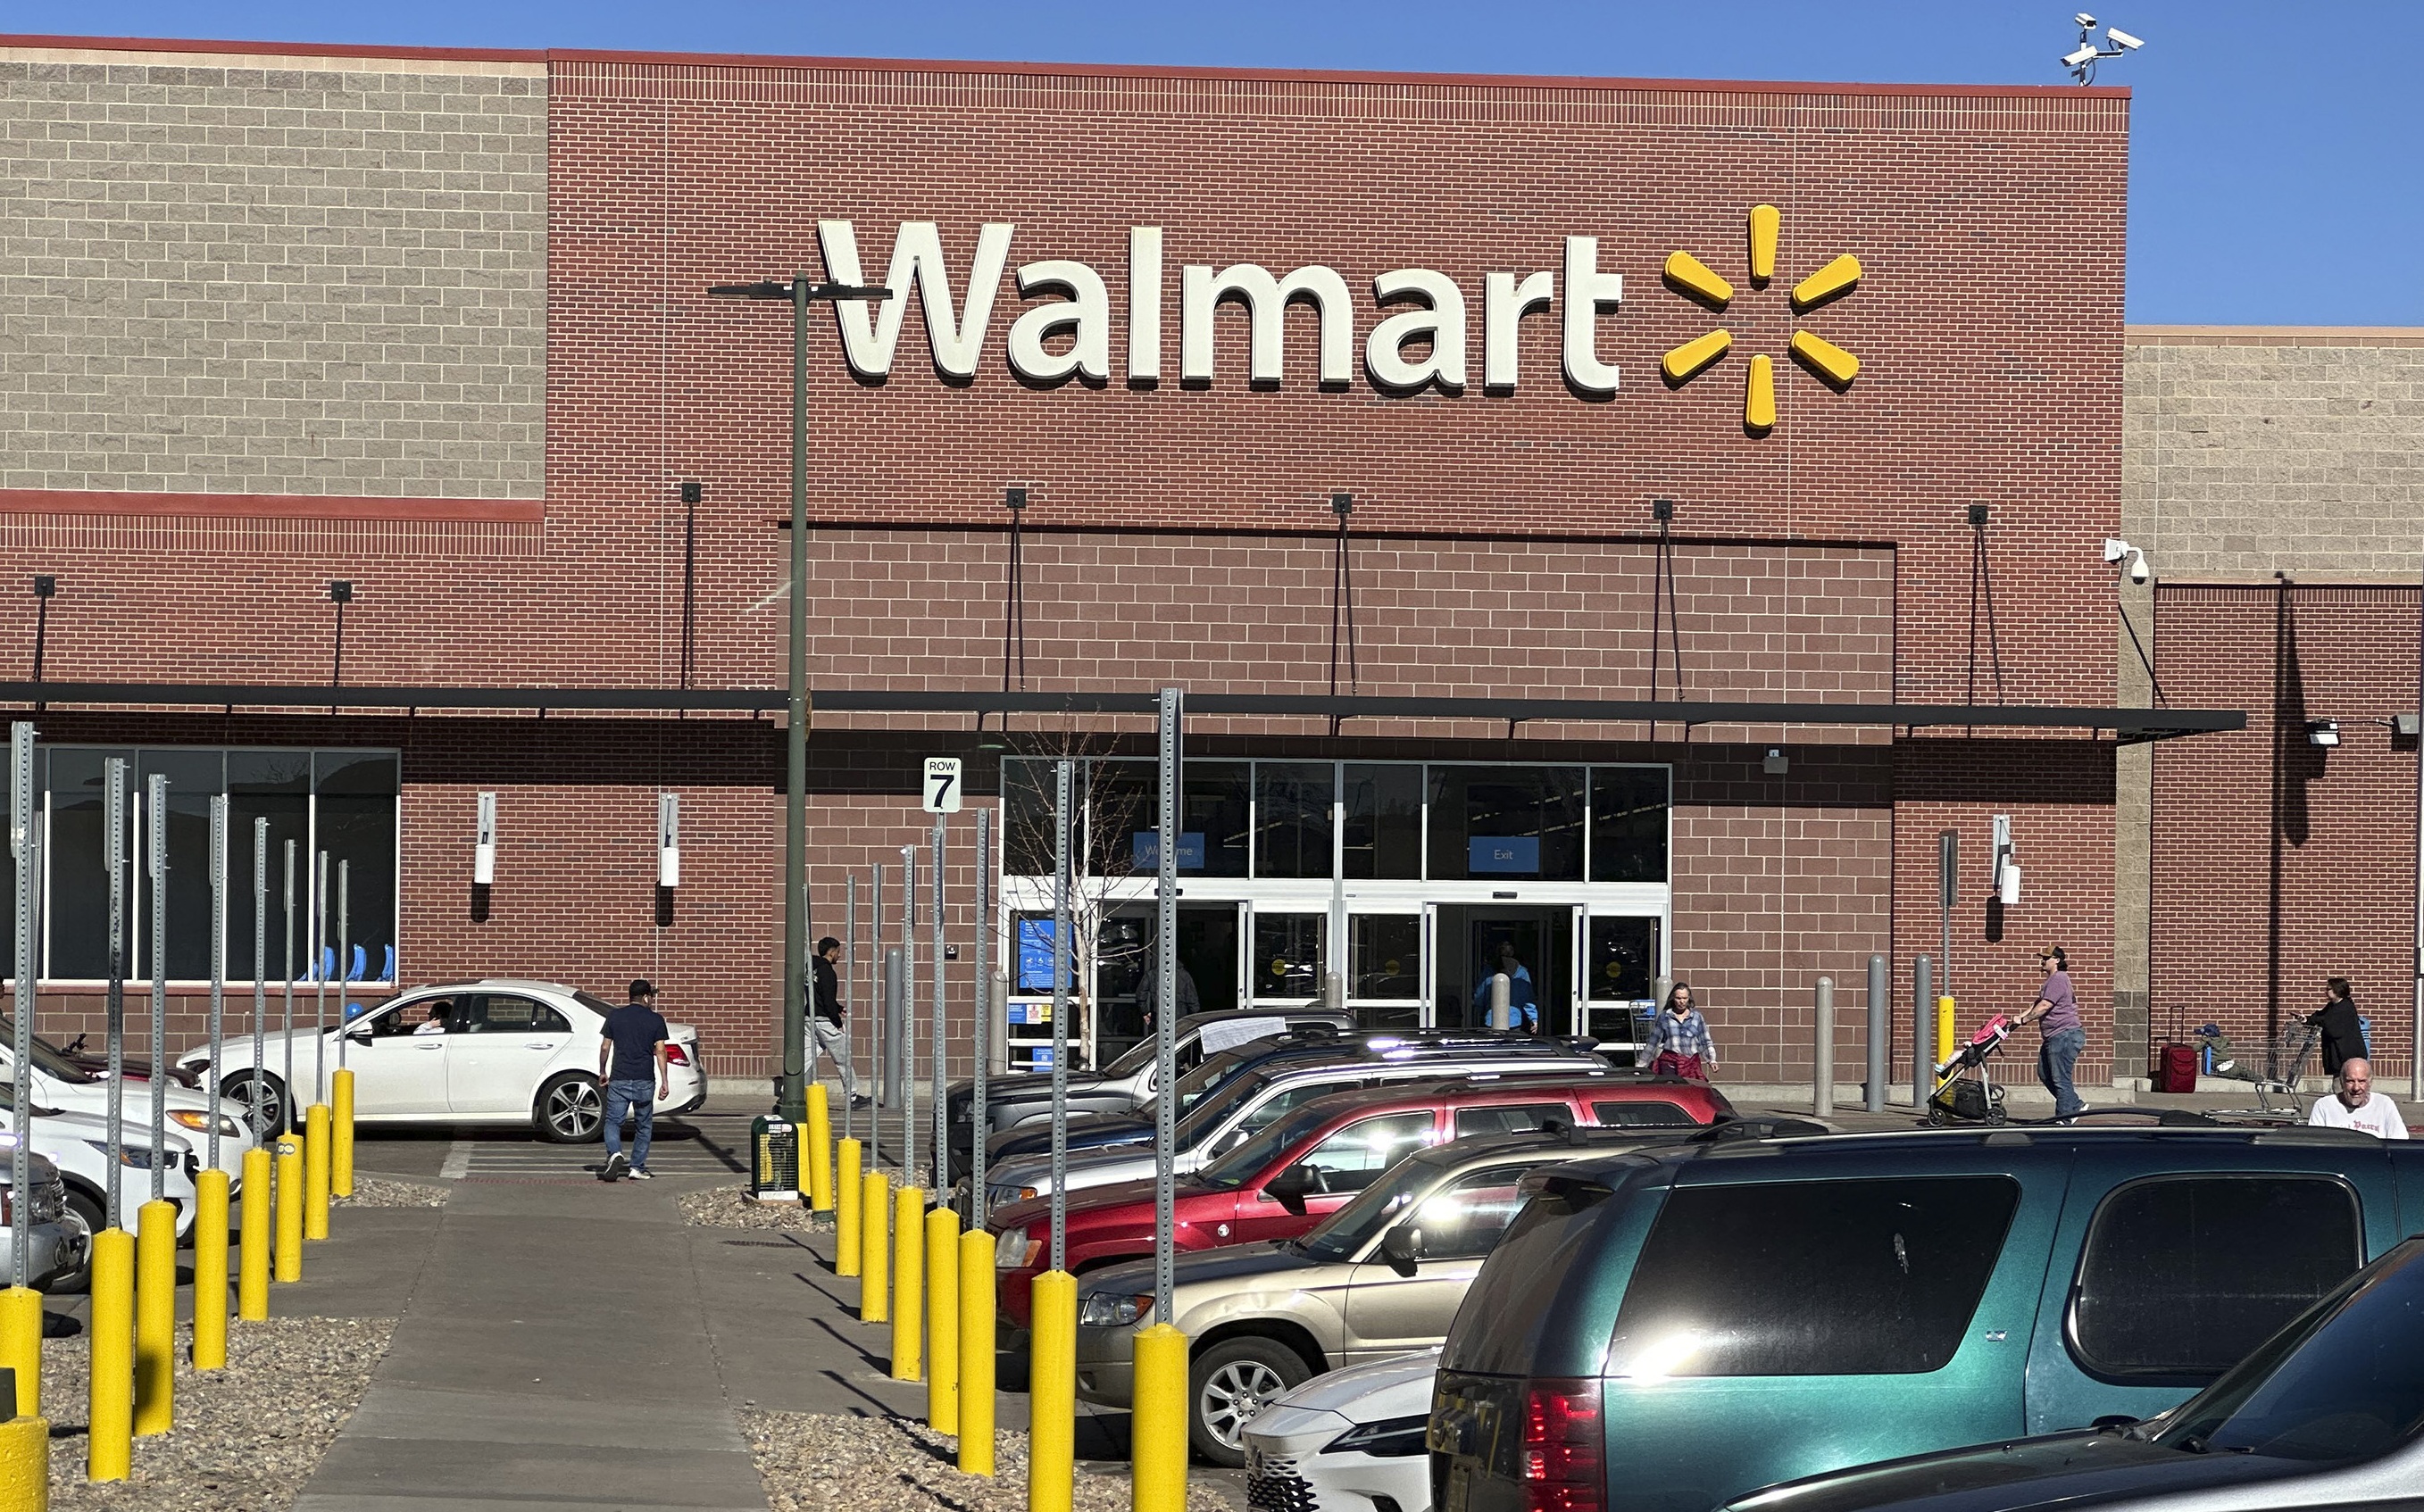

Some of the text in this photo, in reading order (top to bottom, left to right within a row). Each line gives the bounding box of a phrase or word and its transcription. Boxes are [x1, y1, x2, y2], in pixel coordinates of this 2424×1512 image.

[818, 220, 1623, 391] Walmart
[929, 761, 955, 771] ROW
[930, 774, 954, 808] 7
[1145, 844, 1193, 856] Weome
[1494, 849, 1513, 860] Exit
